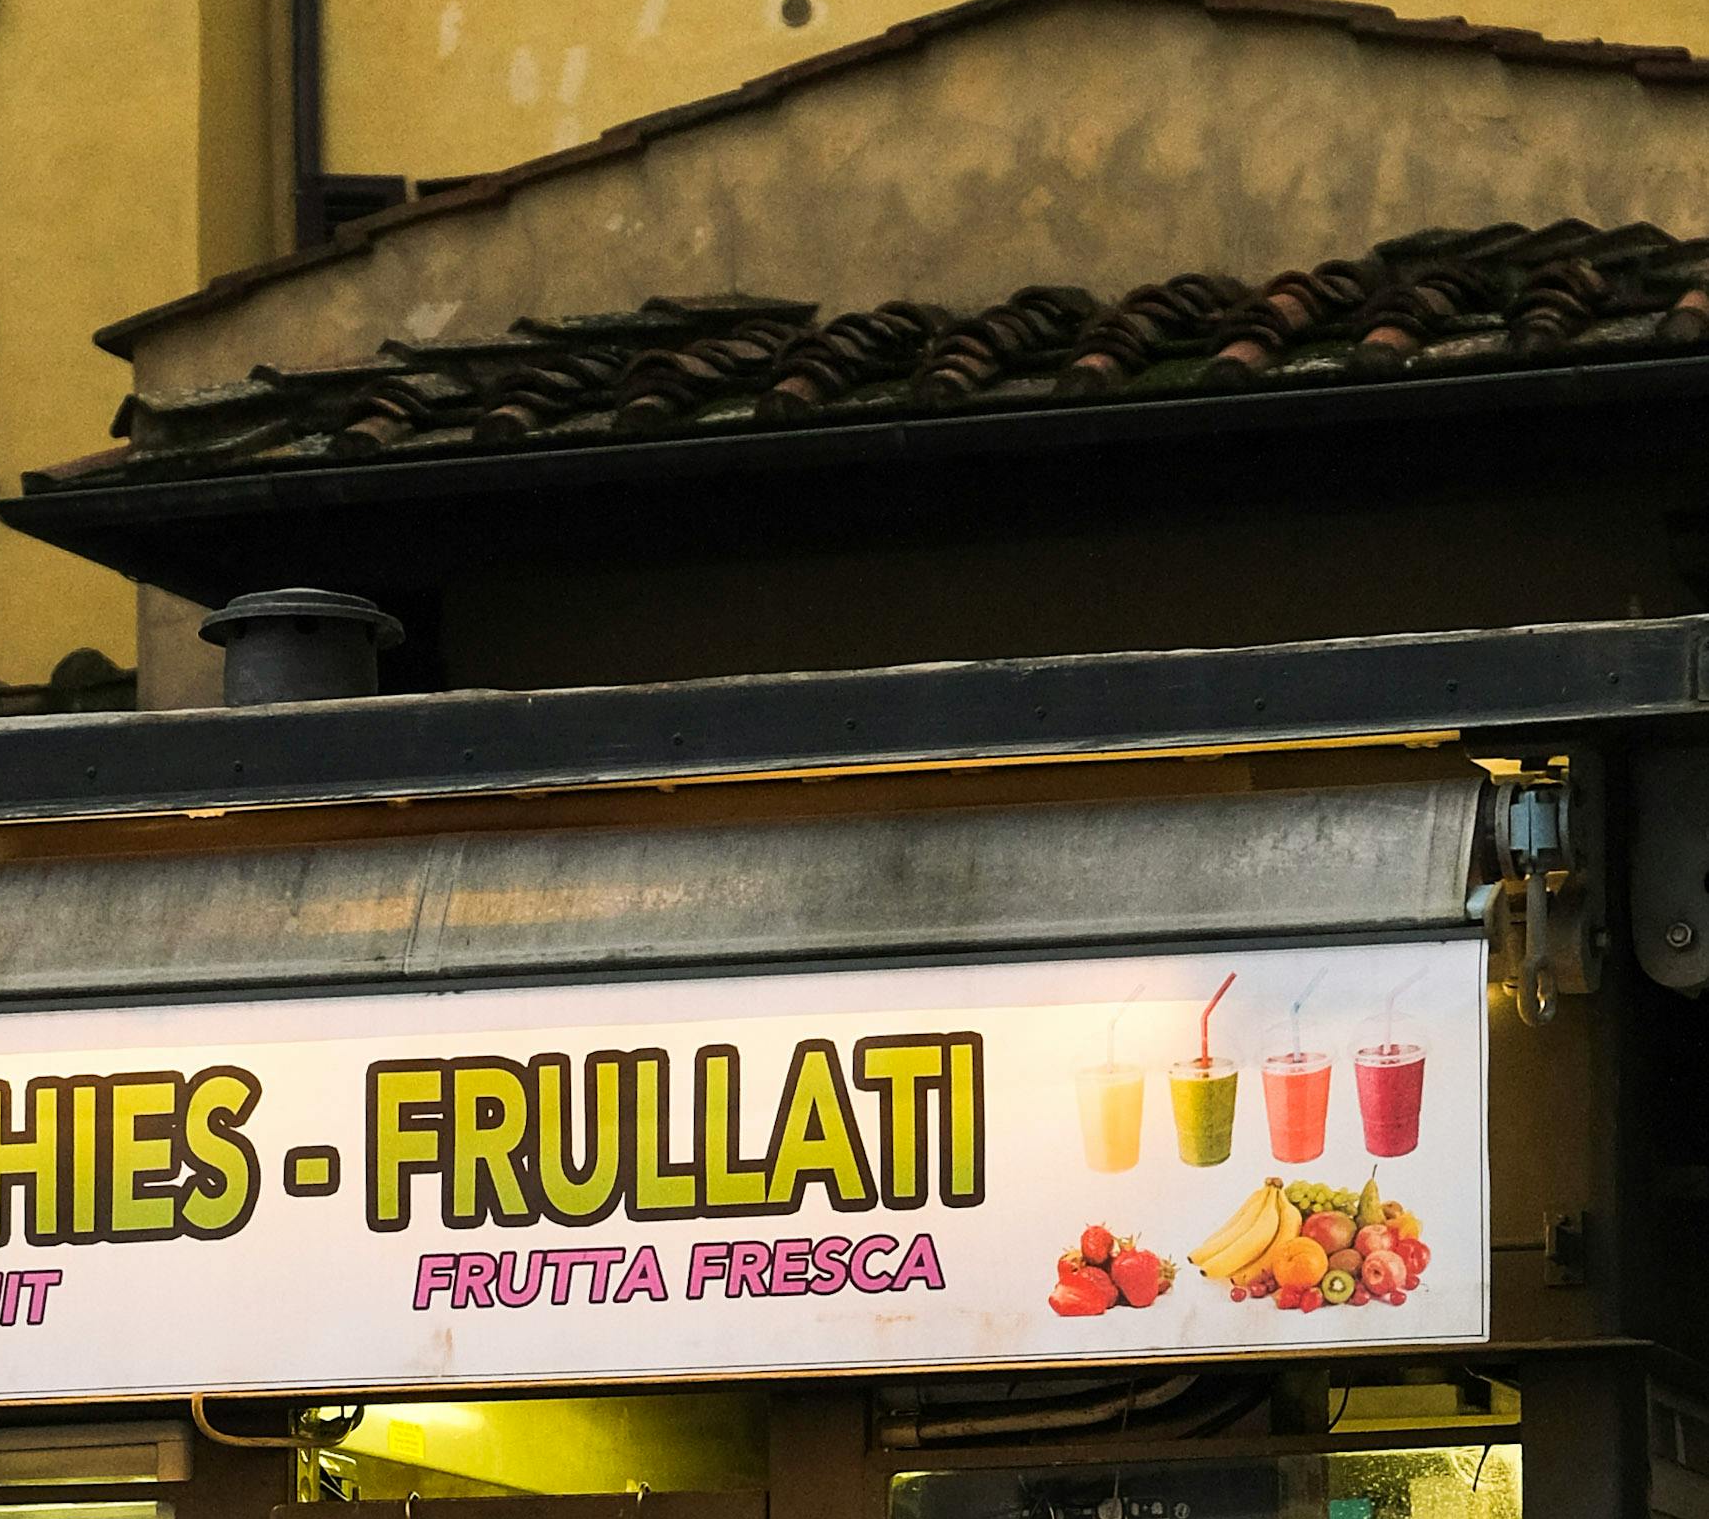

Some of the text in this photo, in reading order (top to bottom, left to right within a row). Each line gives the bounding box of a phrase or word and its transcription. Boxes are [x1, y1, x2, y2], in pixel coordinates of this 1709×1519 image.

[366, 1031, 985, 1232] FRULLATI
[413, 1233, 945, 1311] FRUTTA FRESCA
